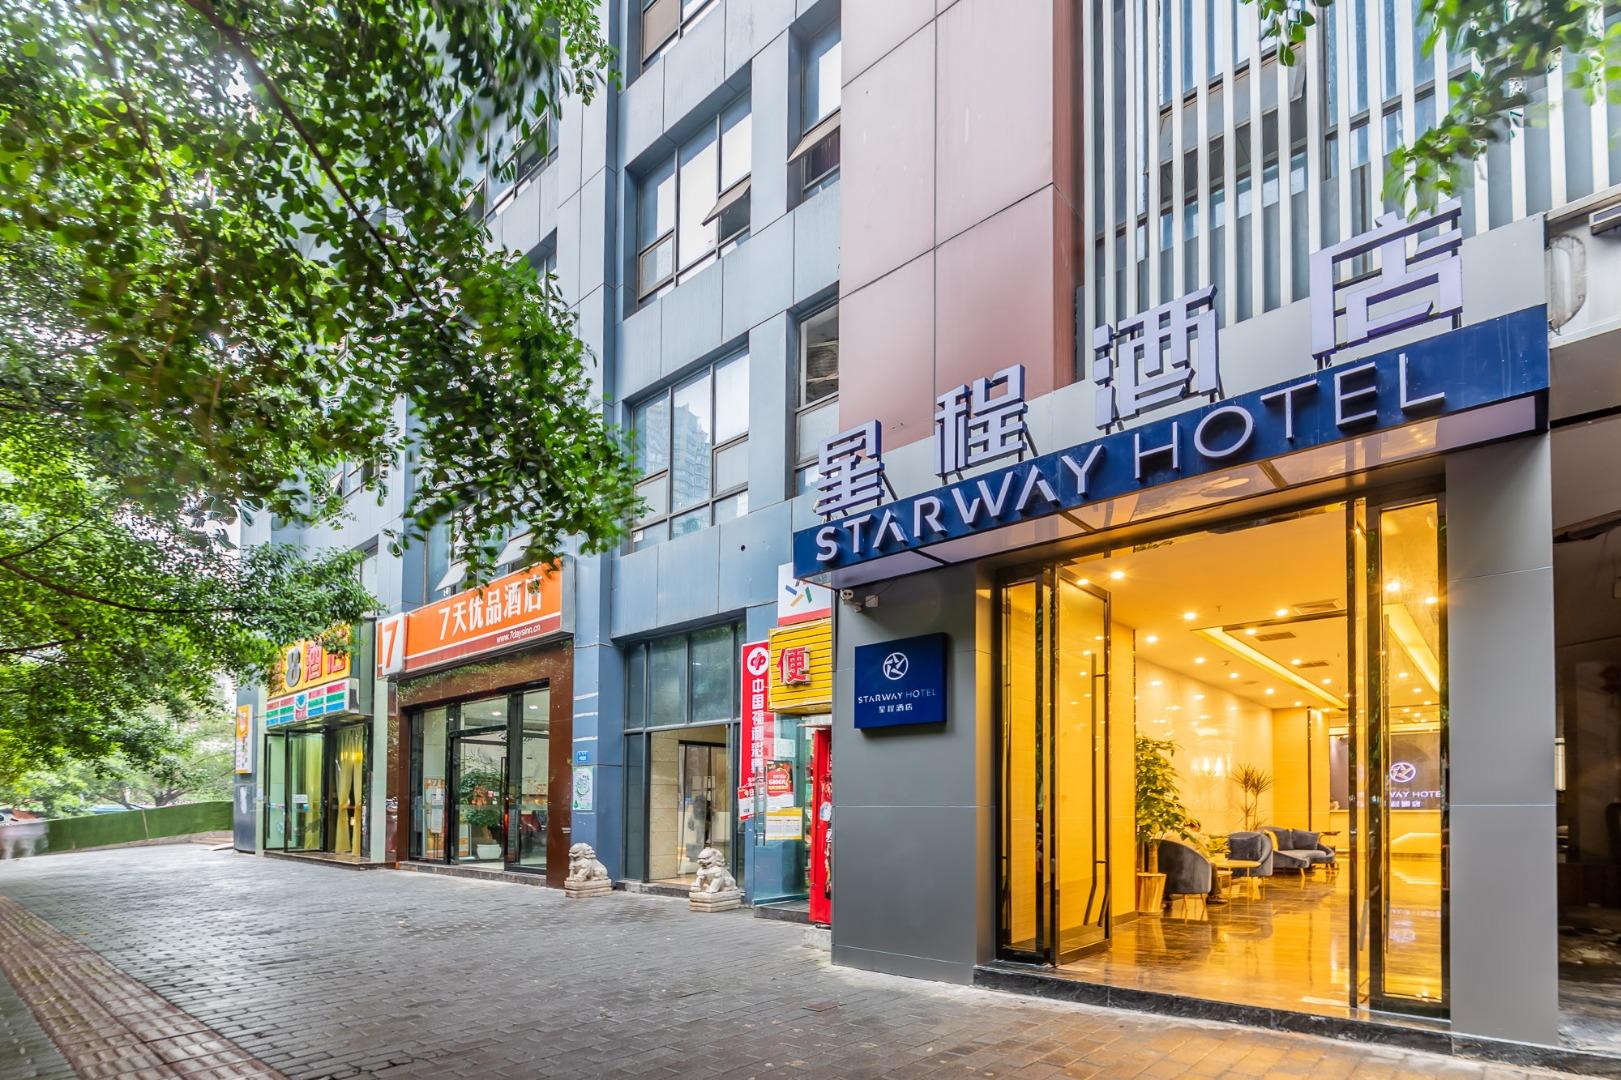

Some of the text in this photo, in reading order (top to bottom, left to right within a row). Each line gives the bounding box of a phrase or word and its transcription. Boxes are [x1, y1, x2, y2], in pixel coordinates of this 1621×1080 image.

[815, 197, 1463, 519] 星程酒店
[815, 352, 1446, 563] STARWAY HOTEL
[438, 575, 542, 641] 7天优品酒店
[496, 624, 541, 644] www.7daysinn.cn
[777, 646, 809, 685] 便
[858, 688, 937, 704] STARWAY HOTEL
[878, 703, 913, 714] 星程酒店
